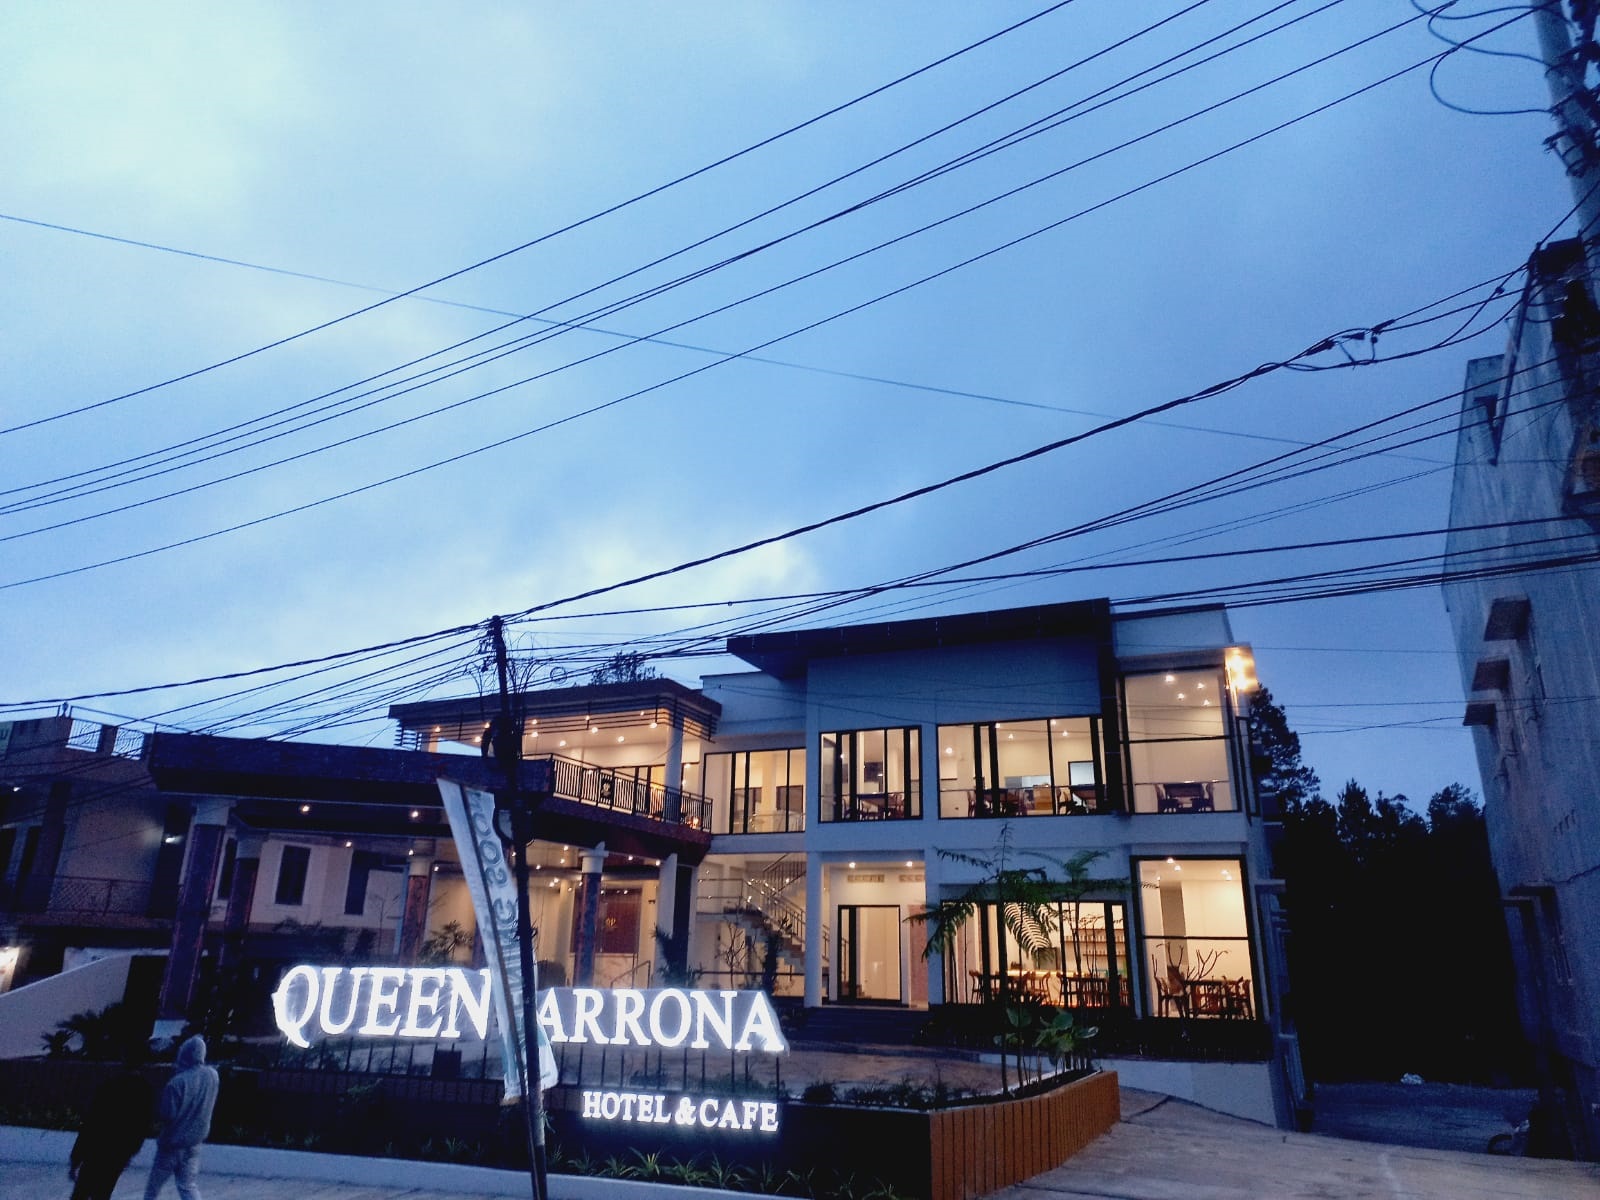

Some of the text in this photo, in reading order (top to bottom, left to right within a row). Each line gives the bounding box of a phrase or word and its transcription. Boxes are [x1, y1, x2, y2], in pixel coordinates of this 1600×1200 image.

[271, 965, 786, 1052] QUEEN ARRONA
[582, 1091, 779, 1131] HOTEL & CAFE
